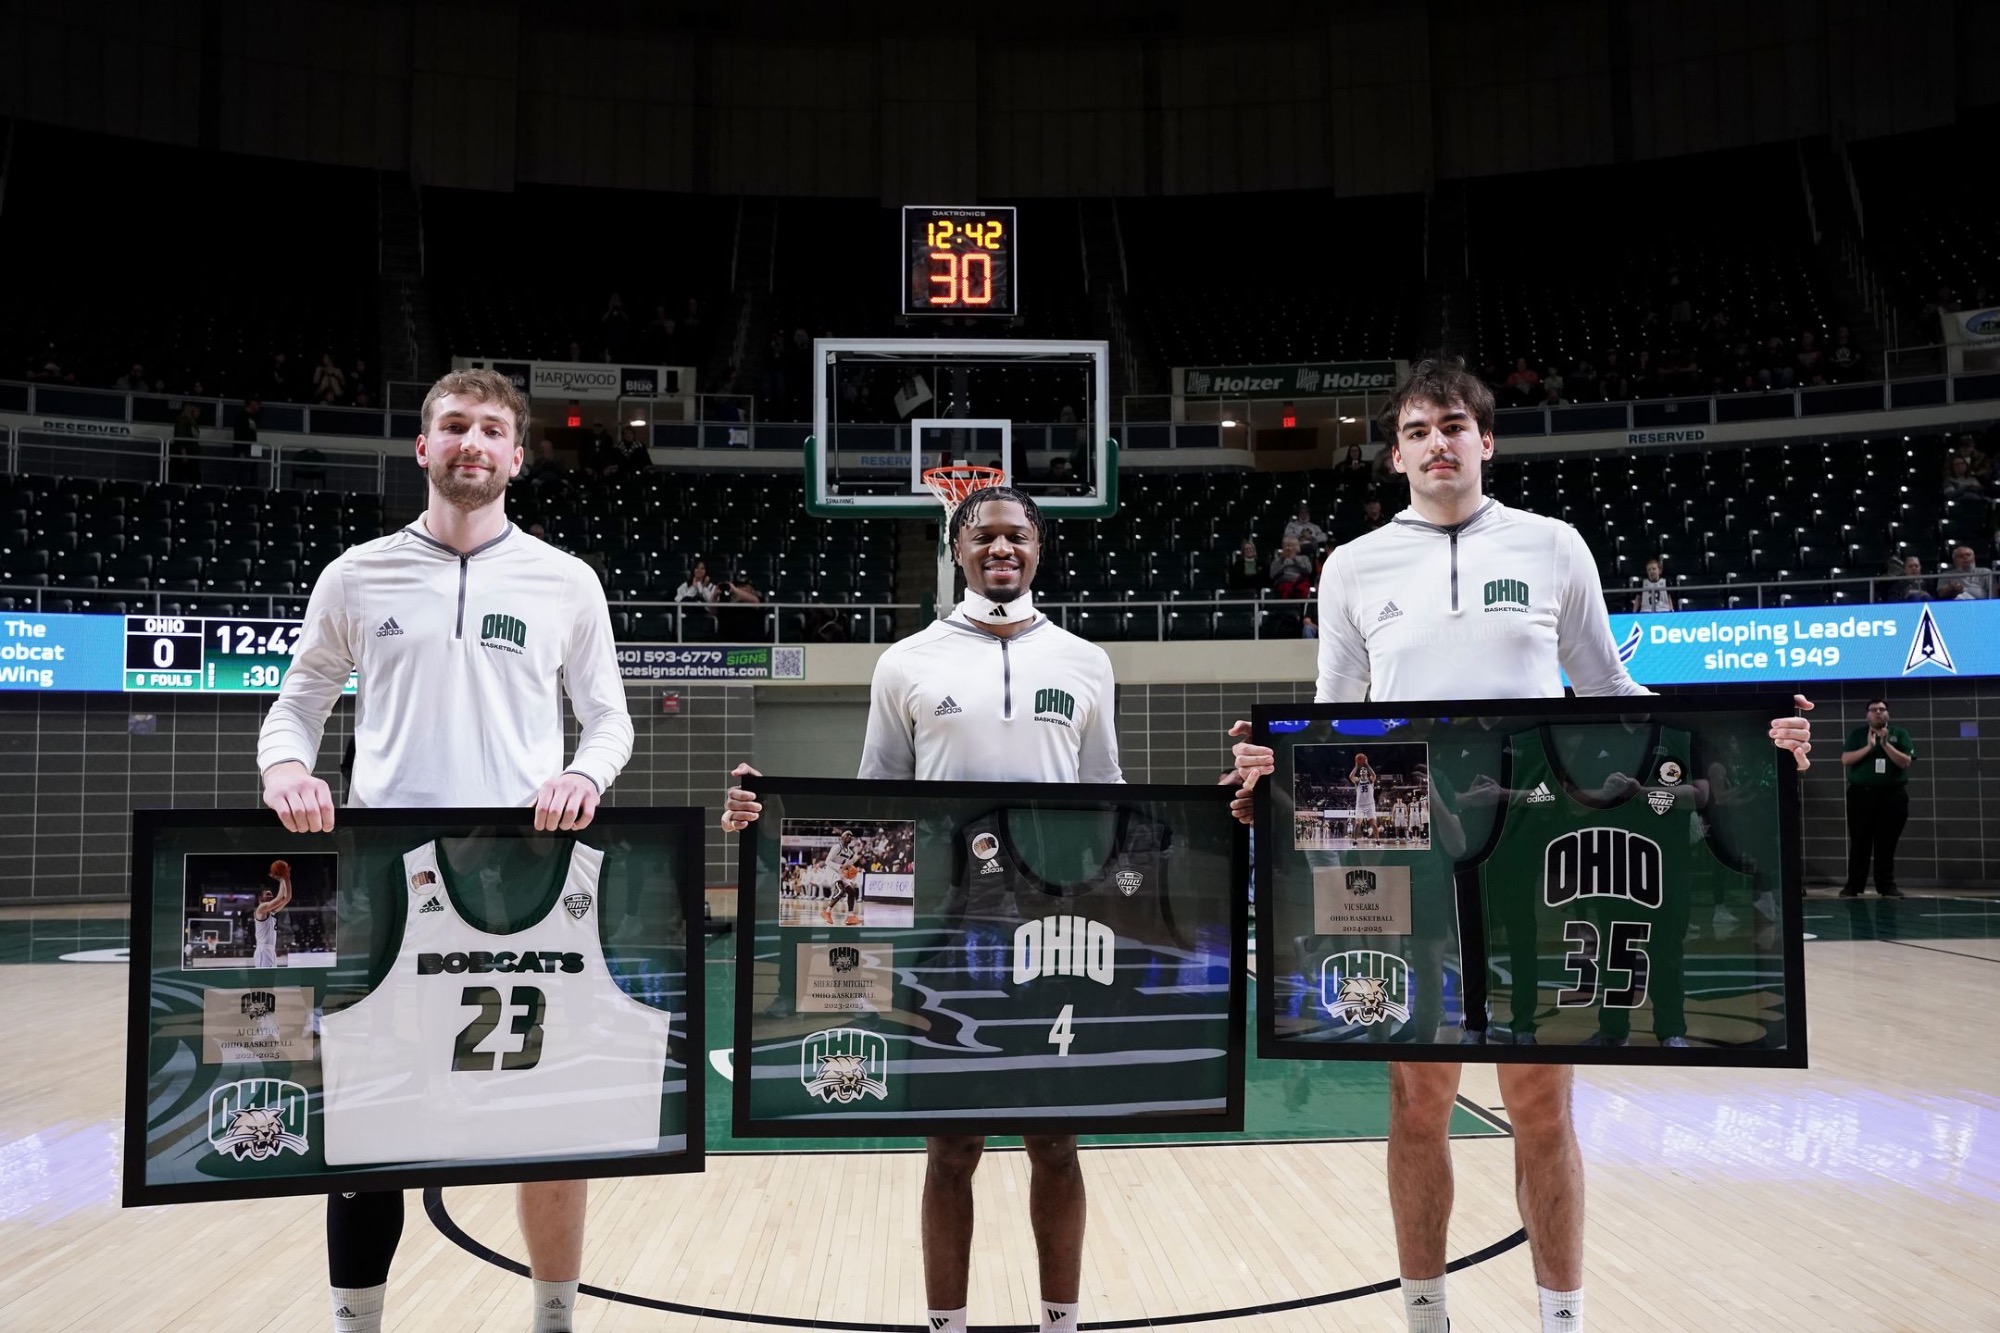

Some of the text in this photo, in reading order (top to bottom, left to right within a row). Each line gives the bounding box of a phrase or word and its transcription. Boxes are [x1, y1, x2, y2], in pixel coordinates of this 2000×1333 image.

[928, 221, 1002, 249] 12:42
[930, 253, 991, 304] 30
[535, 370, 617, 387] HARDWOOD
[625, 379, 654, 392] Blue
[1214, 377, 1284, 391] Holzer
[1323, 373, 1394, 388] Holzer
[1628, 430, 1704, 444] RESERVED
[860, 456, 930, 466] RESERVD
[1484, 579, 1529, 607] OHIO
[1377, 610, 1404, 622] adidas
[4, 619, 47, 637] The
[145, 619, 185, 633] OHIO
[376, 627, 403, 638] adidas
[481, 613, 526, 648] OHIO
[1650, 617, 1897, 646] Developing Leaders
[0, 642, 65, 661] obcat
[153, 638, 175, 668] 0
[480, 641, 524, 655] BASKETBALL
[617, 650, 641, 663] 40)
[644, 650, 722, 663] 593-6779
[726, 653, 767, 666] SIGNS
[1704, 646, 1840, 670] since 1949
[0, 666, 54, 688] Wing
[243, 665, 280, 687] :30
[618, 665, 768, 679] ncesignsofathens.com
[136, 674, 193, 687] 0 FOULS
[934, 706, 963, 717] adidas
[1035, 688, 1075, 721] OHIO
[1034, 715, 1071, 728] BASKETBALL
[1526, 794, 1556, 804] adidas
[1648, 798, 1674, 806] MAC
[980, 866, 1004, 875] adidas
[1544, 827, 1663, 909] OHIO
[1346, 870, 1376, 890] OHIO
[419, 903, 444, 914] adidas
[567, 901, 590, 909] MAC
[1344, 903, 1380, 911] VIC SEARLS
[829, 947, 859, 967] OHIO
[1013, 915, 1115, 986] OHIO
[417, 951, 584, 975] BOBCATS
[1557, 921, 1651, 1008] 35
[842, 980, 875, 988] MITCHELL
[1322, 950, 1408, 1008] OHIO
[241, 991, 276, 1014] OHIO
[236, 1027, 280, 1037] AJ CLAYTON
[451, 986, 546, 1072] 23
[1048, 1004, 1075, 1057] 4
[221, 1040, 295, 1049] OHIO BASKETBALL
[234, 1051, 280, 1060] 2021-2025
[801, 1028, 887, 1085] OHIO
[208, 1078, 309, 1143] OHIO
